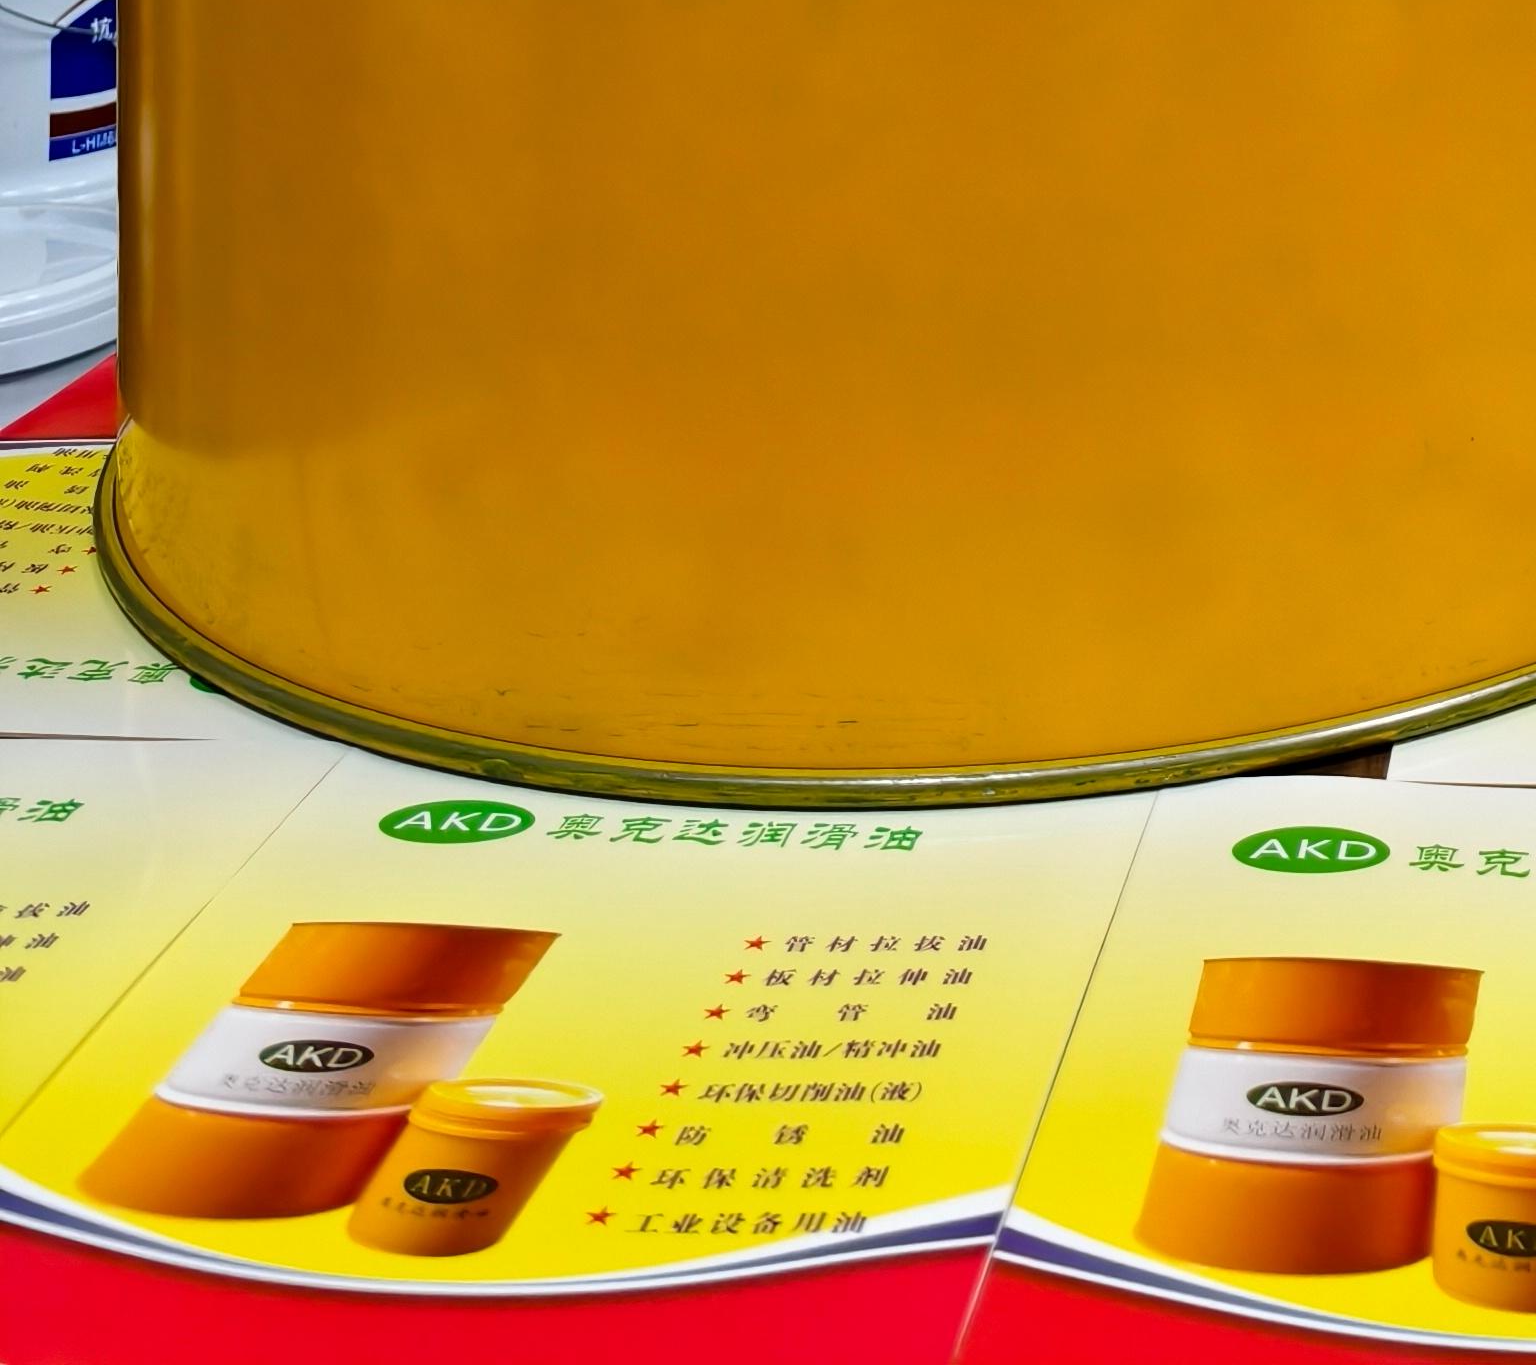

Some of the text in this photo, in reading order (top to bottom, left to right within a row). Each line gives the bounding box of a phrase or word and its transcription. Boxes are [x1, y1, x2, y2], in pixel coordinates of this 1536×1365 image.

[394, 807, 923, 853] AKD 奥克达润滑油
[1248, 837, 1379, 863] AKD
[784, 934, 988, 953] 管材拉拔油
[764, 968, 973, 987] 板材拉伸油
[264, 1045, 364, 1068] AKD
[721, 1039, 943, 1060] 冲压油/精冲油
[697, 1080, 923, 1103] 环保切削油(液)
[1255, 1085, 1353, 1112] AKD
[650, 1165, 890, 1190] 环保清洗剂
[624, 1210, 868, 1236] 工业设备用油
